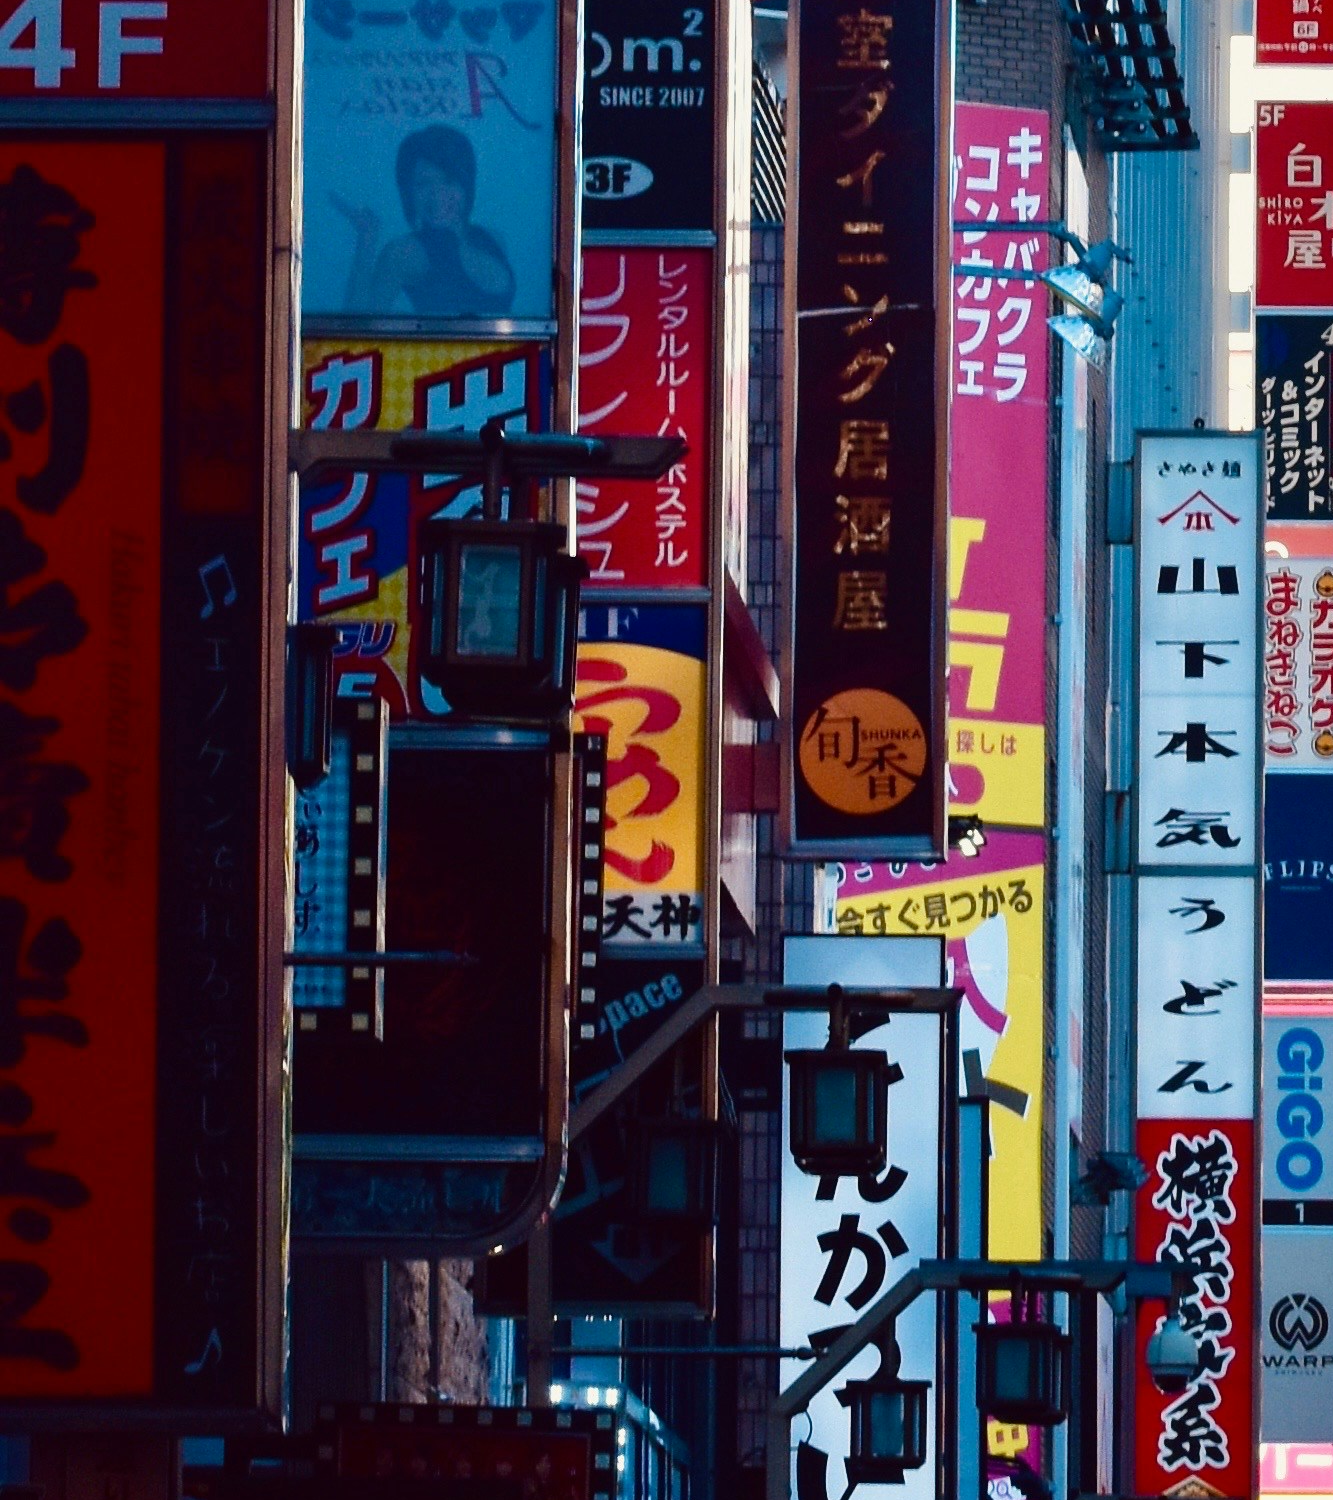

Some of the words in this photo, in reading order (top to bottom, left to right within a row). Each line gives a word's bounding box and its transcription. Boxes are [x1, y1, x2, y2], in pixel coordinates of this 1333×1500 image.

[600, 85, 655, 107] SINCE
[659, 85, 706, 107] 2007
[1258, 104, 1285, 125] 5F
[953, 144, 1002, 399] コンカフェ
[998, 126, 1045, 404] キャバクラ
[1279, 380, 1301, 495] &コミック
[1304, 349, 1327, 513] インターネット
[860, 728, 923, 742] SHUNKA
[1264, 569, 1302, 759] まねきねこ
[1153, 556, 1243, 1099] 山下本気うどん
